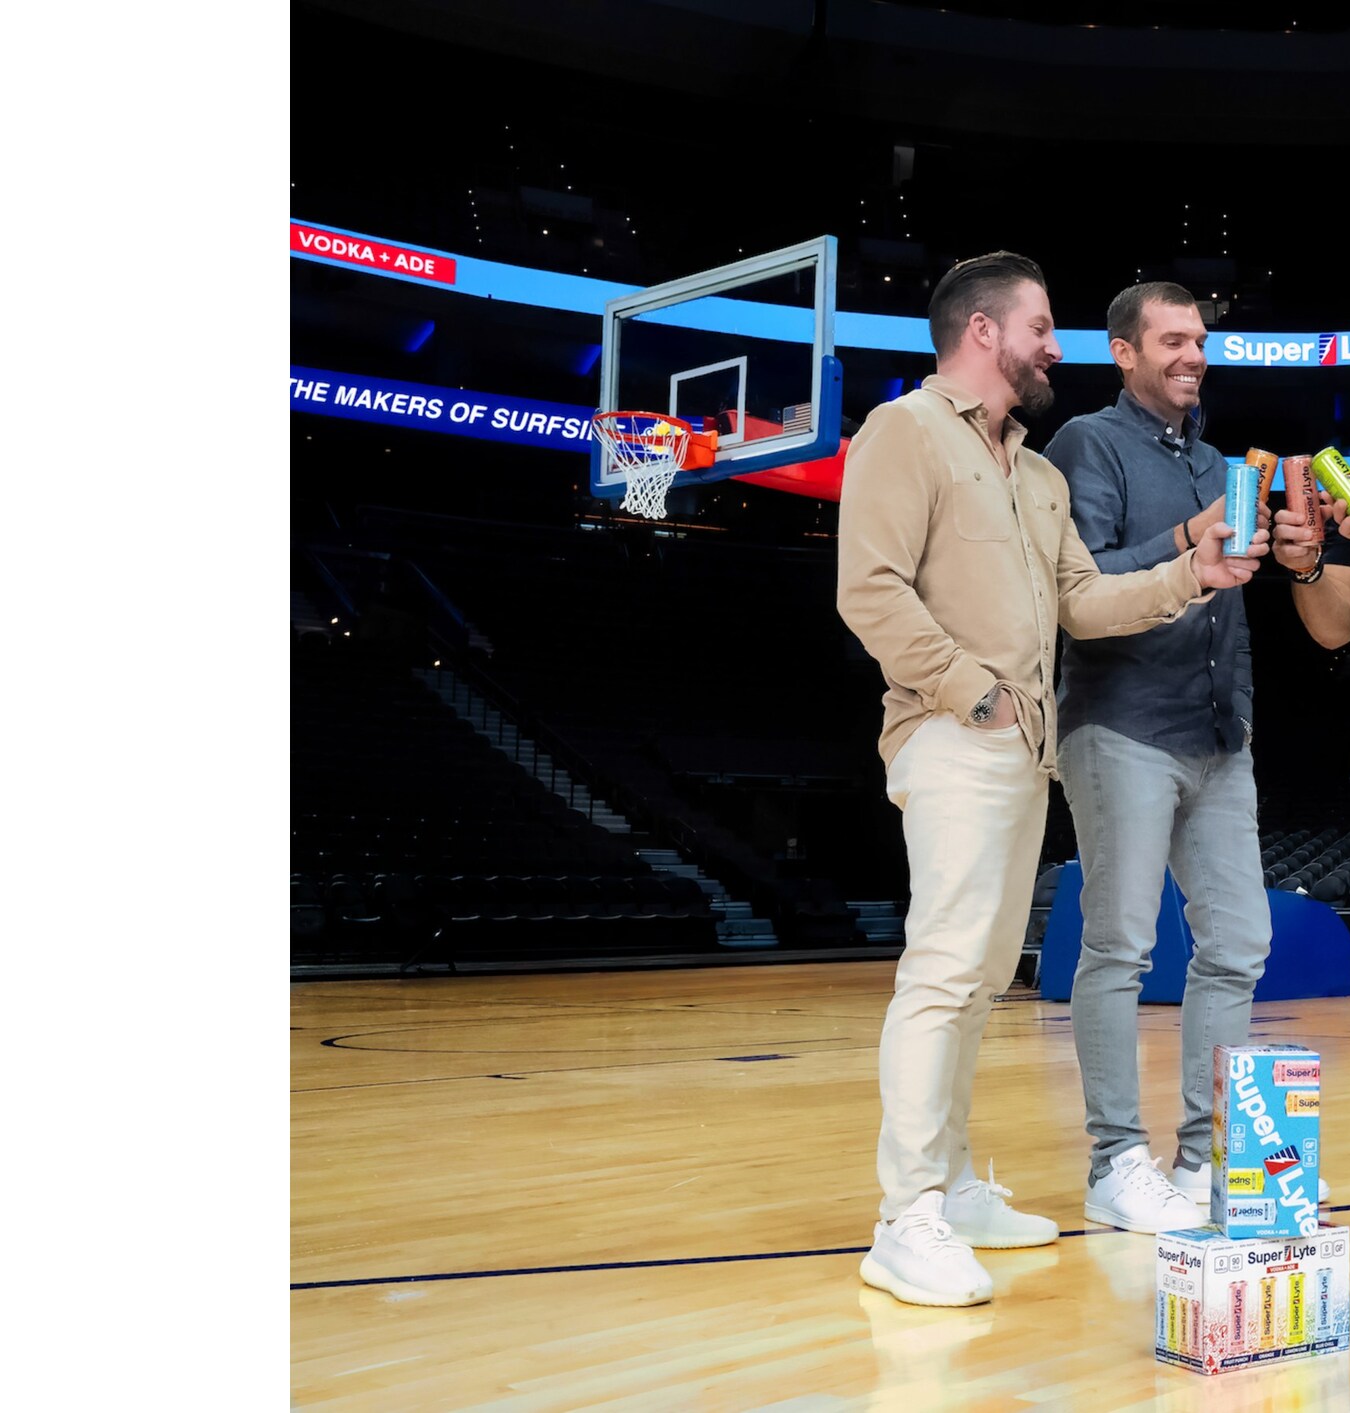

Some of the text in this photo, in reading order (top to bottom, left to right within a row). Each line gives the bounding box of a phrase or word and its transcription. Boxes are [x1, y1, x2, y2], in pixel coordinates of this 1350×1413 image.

[299, 230, 435, 276] VODKA + ADE
[1224, 335, 1315, 366] Super
[290, 378, 330, 402] THE
[334, 386, 443, 420] MAKERS
[450, 401, 486, 425] OF
[491, 408, 626, 444] SURFSI
[1333, 454, 1350, 474] Lyte
[1302, 466, 1316, 527] Super Lyte
[1287, 1069, 1311, 1078] Super
[1230, 1054, 1283, 1147] Super
[1277, 1167, 1319, 1237] Lyte
[1238, 1208, 1263, 1217] Super
[1158, 1246, 1201, 1268] Super Lyte
[1248, 1245, 1316, 1265] Super Lyte
[1335, 1244, 1343, 1252] GF
